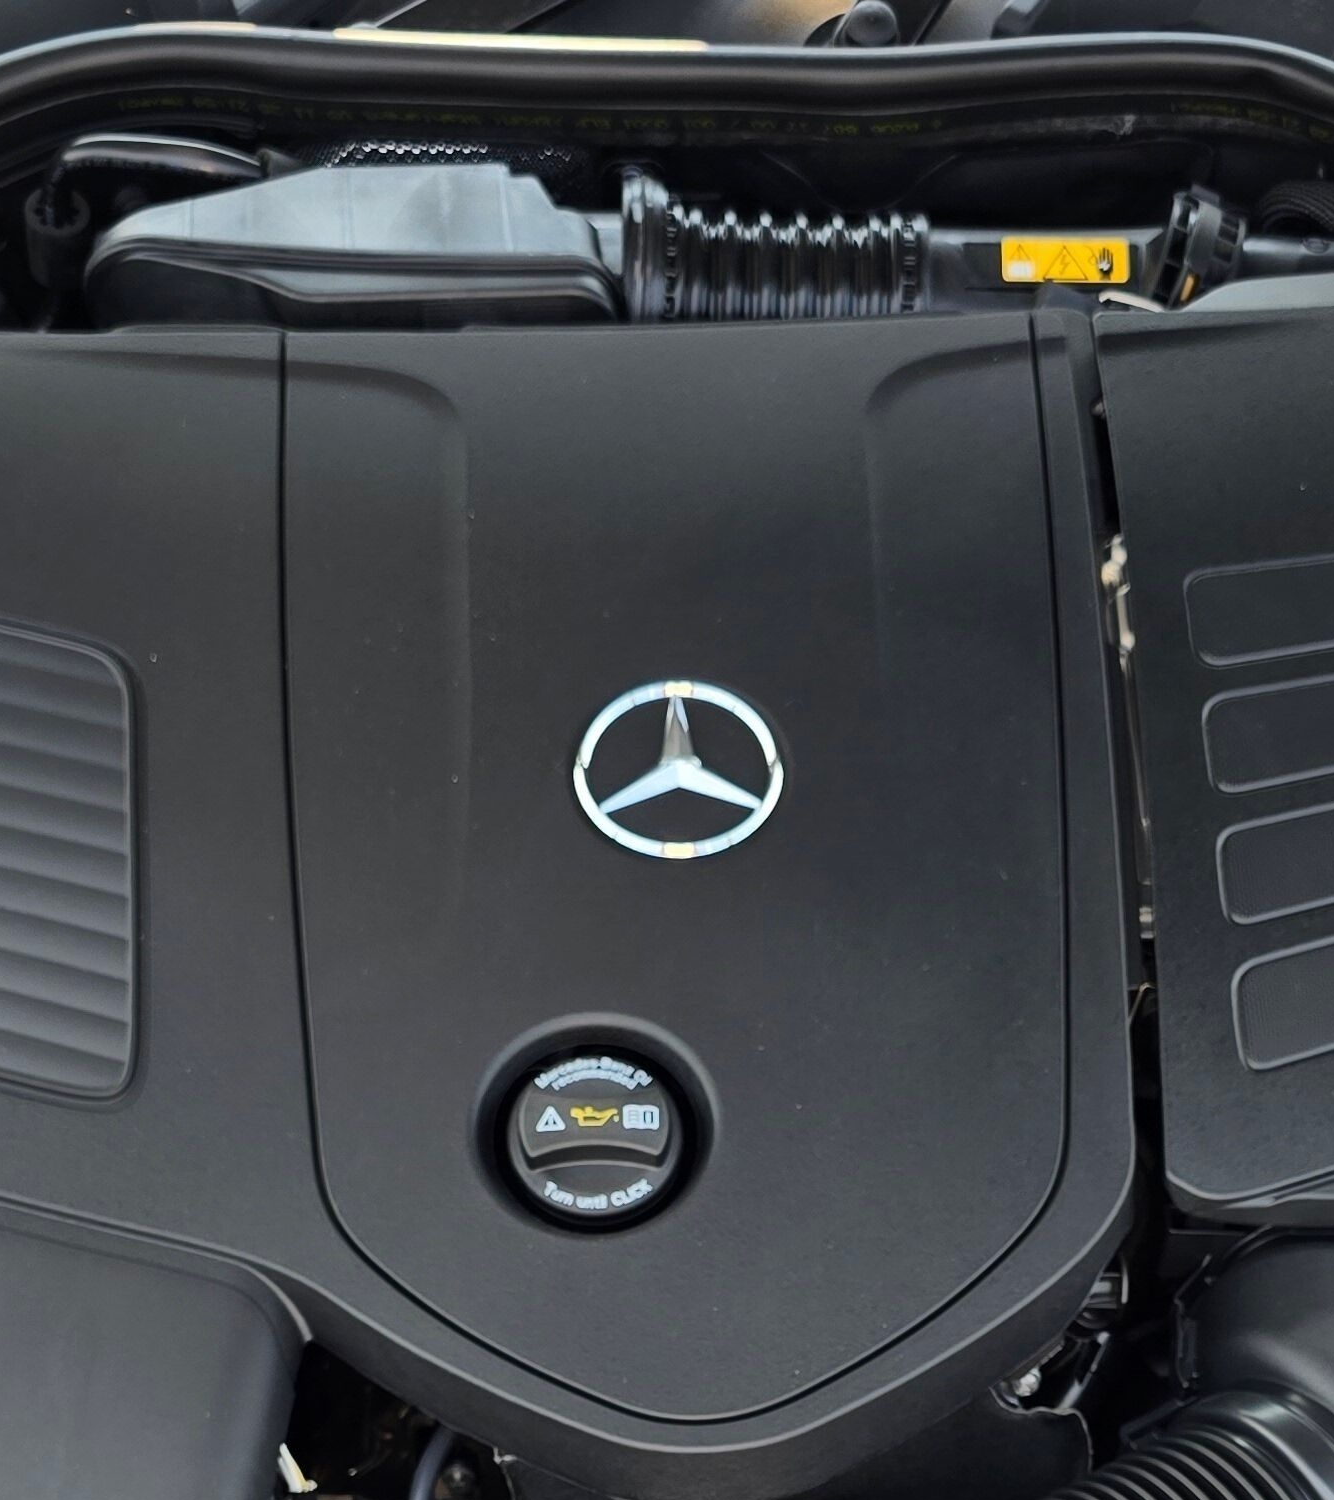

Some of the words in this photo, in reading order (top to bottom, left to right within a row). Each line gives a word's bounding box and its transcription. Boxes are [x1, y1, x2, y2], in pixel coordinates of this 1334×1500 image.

[544, 1180, 575, 1207] Turn
[576, 1193, 609, 1210] until
[610, 1178, 654, 1207] CLICK
